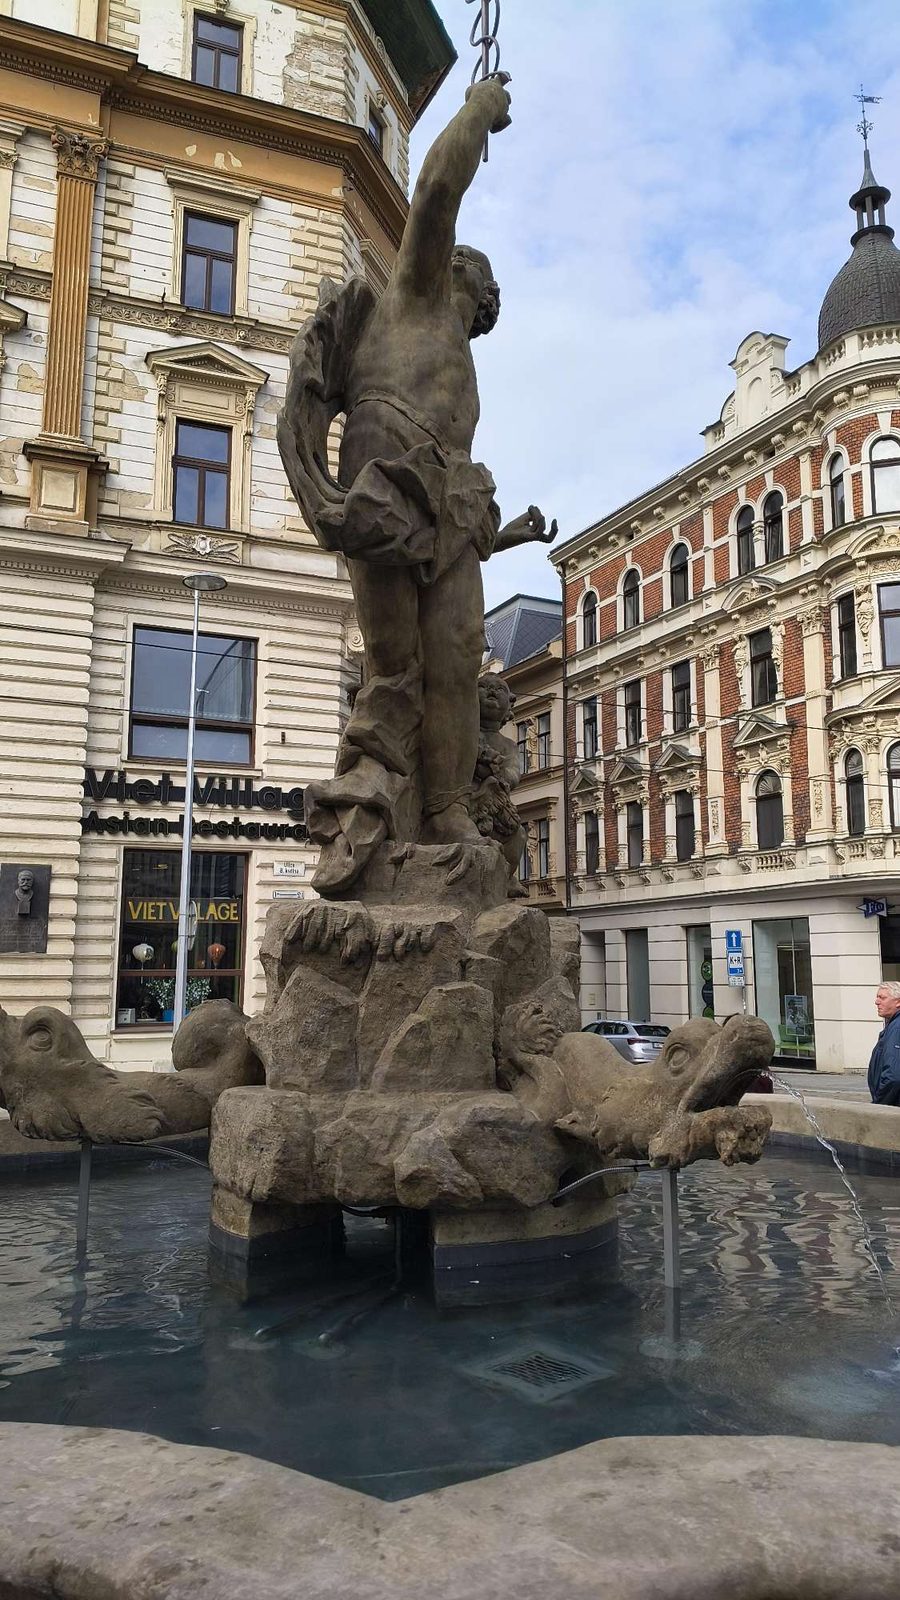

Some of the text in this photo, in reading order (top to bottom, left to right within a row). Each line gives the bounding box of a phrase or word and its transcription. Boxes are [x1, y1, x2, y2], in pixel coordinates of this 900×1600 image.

[84, 769, 173, 805] Viet
[85, 810, 169, 835] Asian
[128, 901, 239, 921] VIET VLAGE
[868, 902, 883, 914] Fio
[729, 956, 742, 965] K+R
